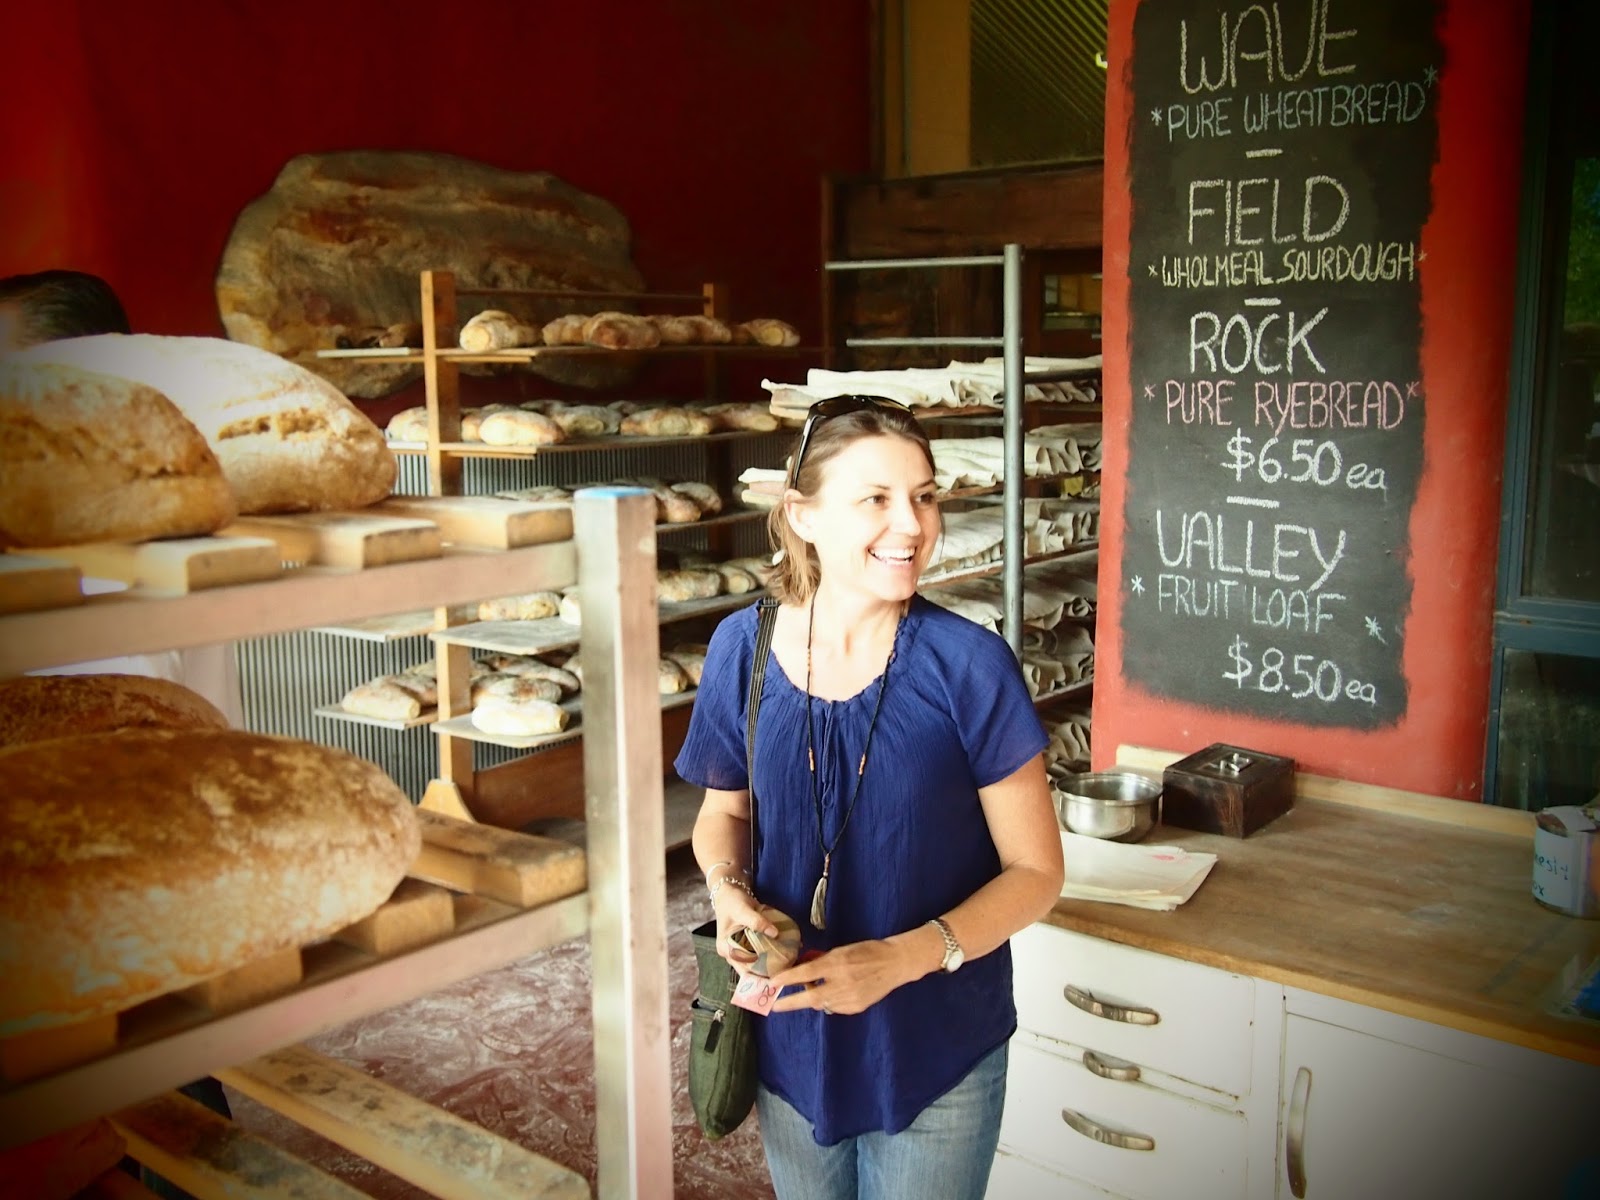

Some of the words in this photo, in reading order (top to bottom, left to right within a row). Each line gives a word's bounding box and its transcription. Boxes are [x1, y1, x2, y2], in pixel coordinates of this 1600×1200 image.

[1180, 0, 1357, 94] WAVE
[1167, 98, 1232, 142] PURE
[1188, 175, 1350, 247] FIELD
[1162, 250, 1273, 288] WHOLMEAL
[1276, 242, 1414, 284] SOURDOUGH
[1189, 307, 1329, 374] ROCK
[1166, 380, 1236, 426] PURE
[1255, 380, 1404, 437] RYEBREAD
[1220, 428, 1342, 486] $6.50
[1346, 463, 1387, 491] ea
[1156, 510, 1346, 593] VALLEY
[1158, 574, 1239, 619] FRUIT
[1252, 586, 1347, 633] LOAF
[1222, 634, 1342, 702] $8.50
[1345, 680, 1376, 707] ea
[757, 984, 777, 1008] 20
